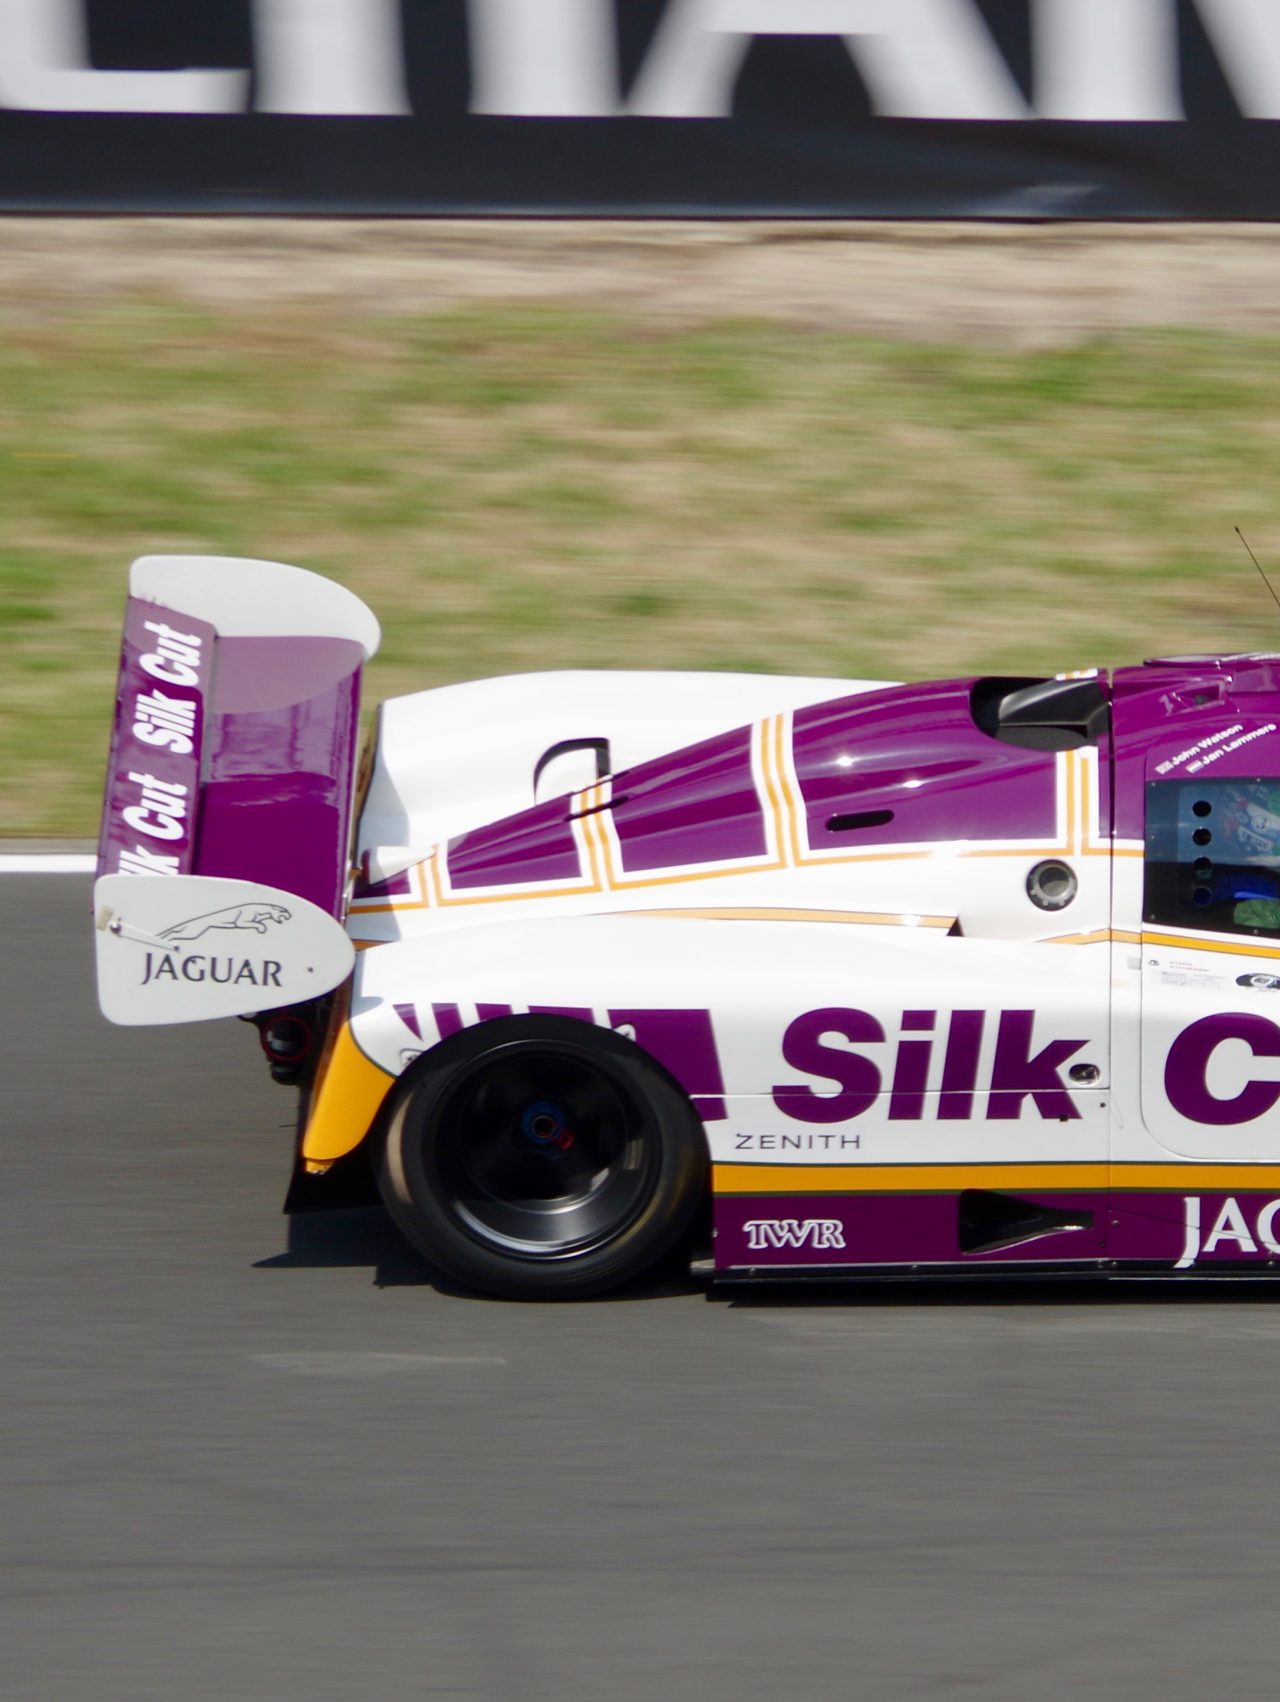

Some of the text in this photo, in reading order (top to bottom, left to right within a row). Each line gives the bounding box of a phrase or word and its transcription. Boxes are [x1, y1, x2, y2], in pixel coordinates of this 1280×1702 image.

[133, 620, 202, 755] Silk Cut
[1172, 723, 1244, 766] John Watson
[1202, 748, 1225, 766] Jan
[117, 771, 188, 876] lk Cut
[141, 952, 283, 987] JAGUAR
[771, 1006, 1093, 1124] Silk
[734, 1132, 861, 1150] ZENITH
[742, 1218, 847, 1250] TWR
